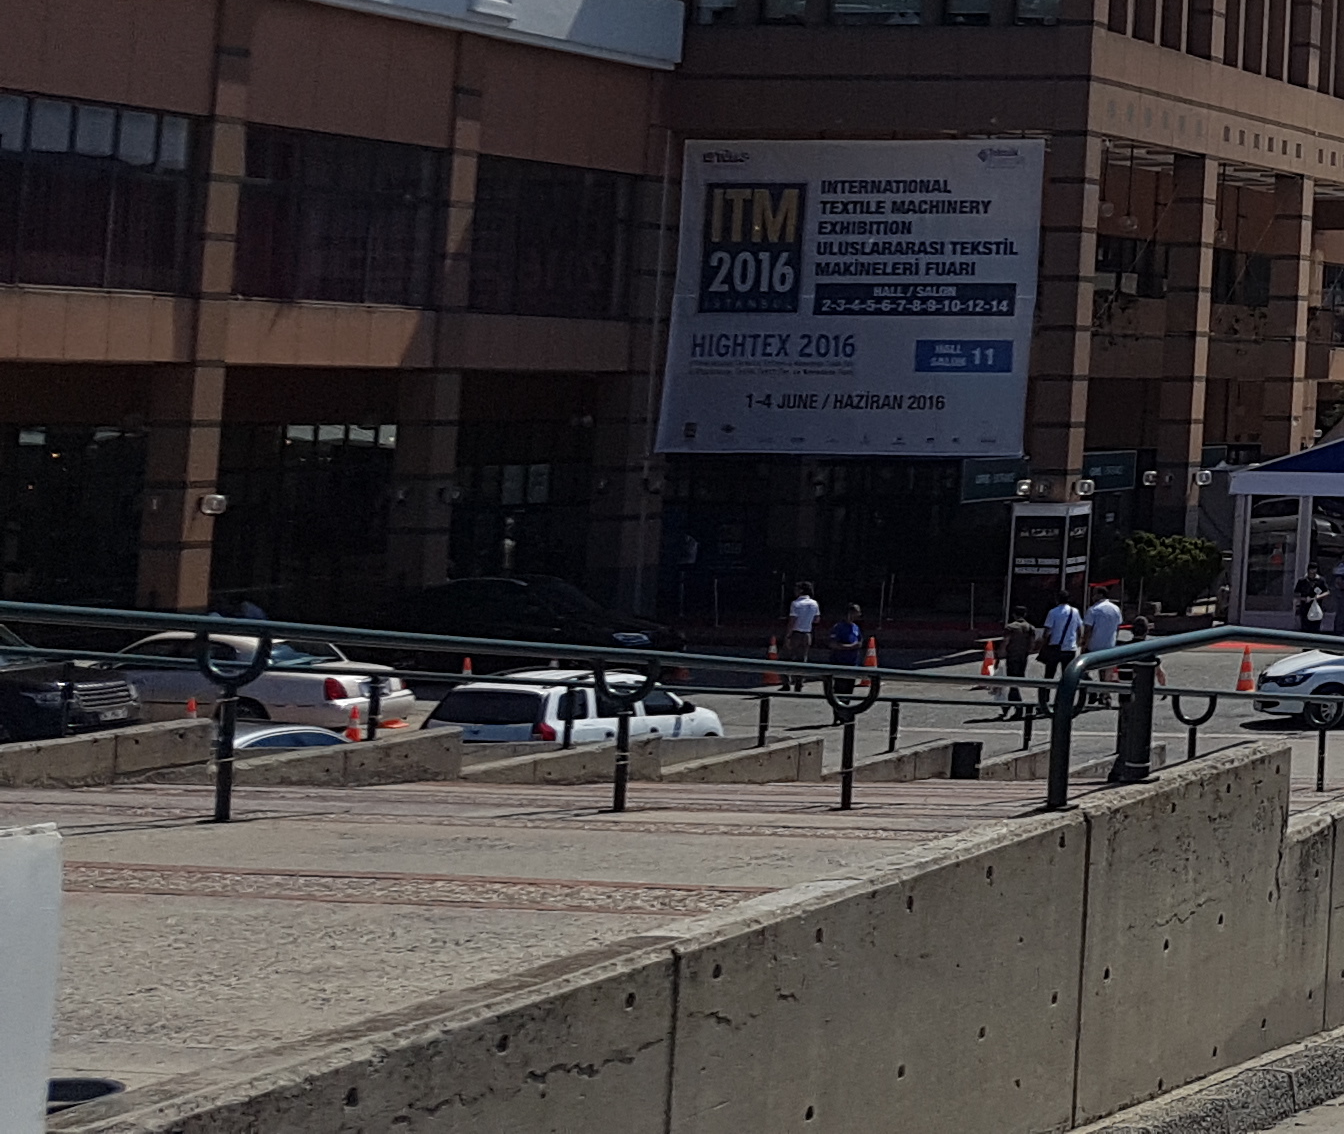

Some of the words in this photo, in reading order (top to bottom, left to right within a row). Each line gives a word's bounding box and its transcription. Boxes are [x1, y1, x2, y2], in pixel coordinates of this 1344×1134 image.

[820, 180, 952, 195] INTERNATIONAL
[711, 188, 797, 243] ITM
[820, 201, 886, 215] TEXTILE
[891, 200, 992, 214] MACHINERY
[817, 220, 912, 236] EXHIBITION
[816, 241, 945, 256] ULUSLARARASI
[951, 237, 1018, 256] TEKSTİL
[708, 250, 795, 293] 2016
[815, 259, 920, 277] MAKİNELERİ
[925, 262, 976, 277] FUARI
[873, 286, 904, 297] HALL
[691, 333, 791, 358] HIGHTEX
[798, 334, 856, 358] 2016
[971, 347, 994, 365] 11
[746, 393, 772, 410] 1-4
[776, 393, 818, 410] JUNE
[833, 390, 903, 410] HAZİRAN
[907, 394, 946, 410] 2016
